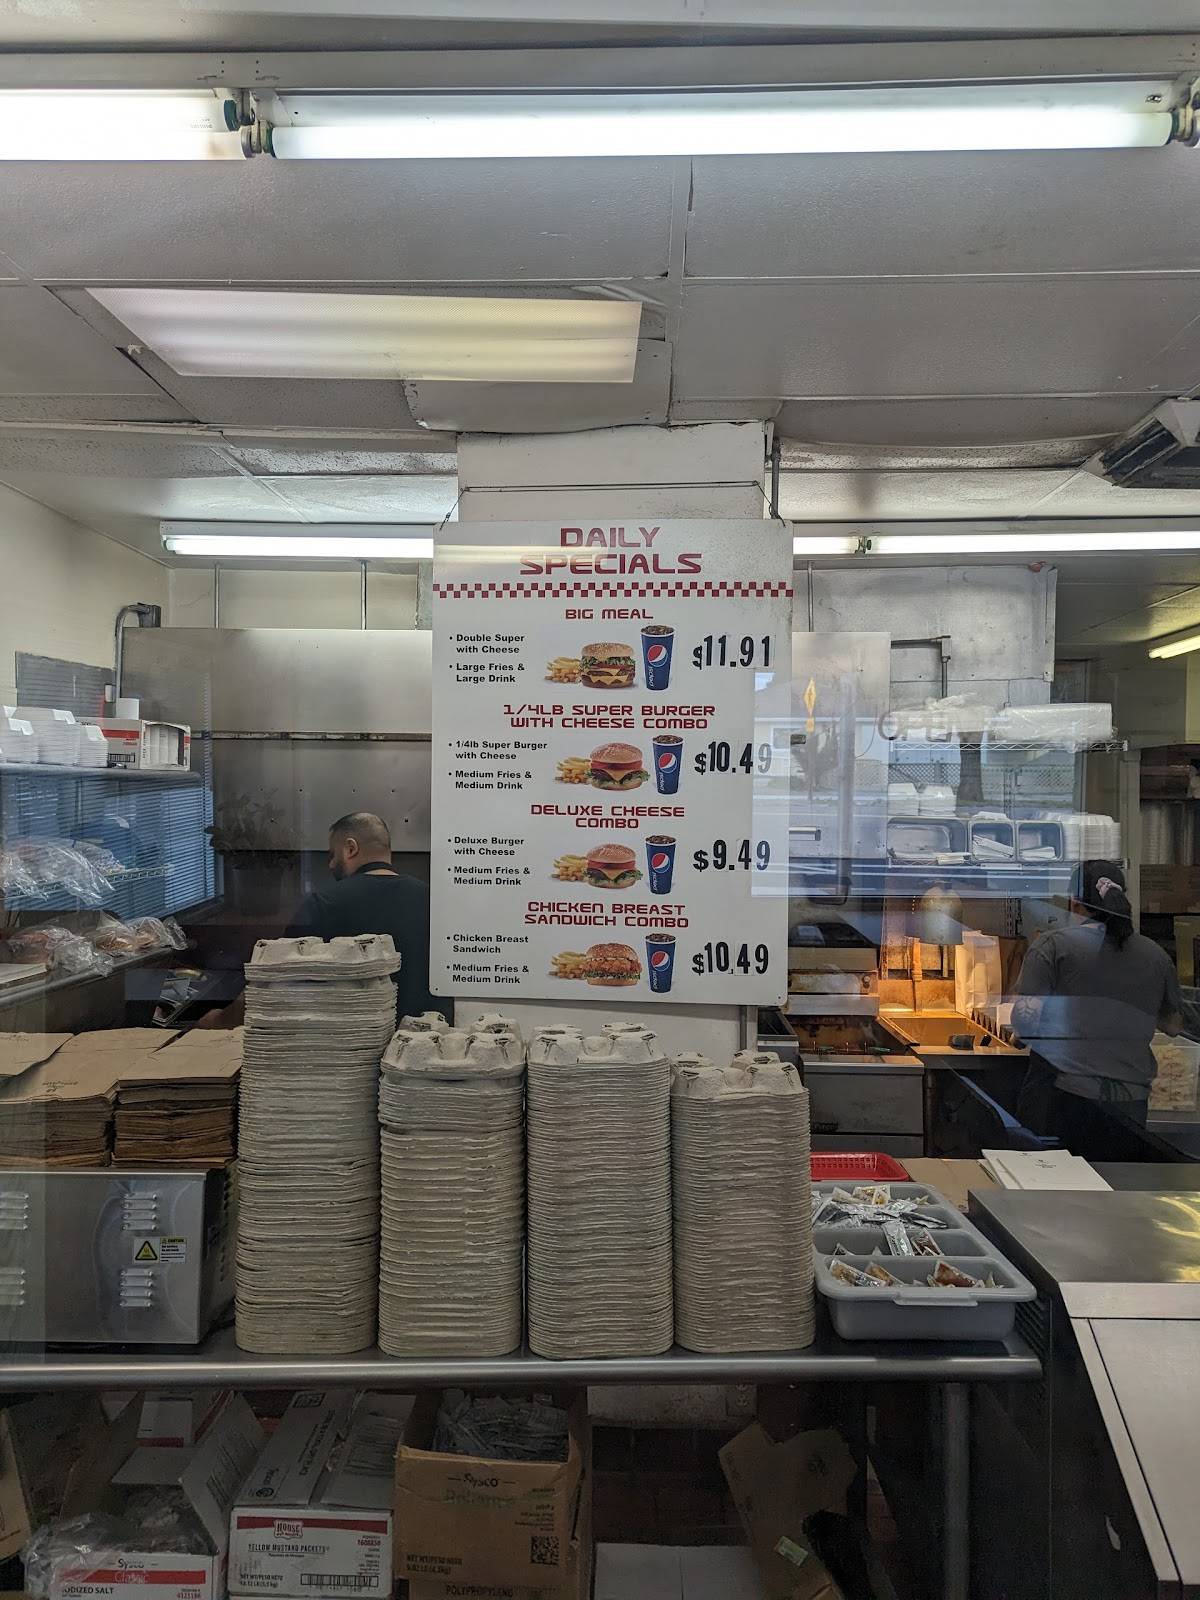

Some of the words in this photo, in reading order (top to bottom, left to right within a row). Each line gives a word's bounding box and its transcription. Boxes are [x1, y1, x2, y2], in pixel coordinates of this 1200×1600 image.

[560, 527, 661, 548] DAILY
[519, 553, 702, 575] SPECIALS
[565, 608, 594, 620] BIG
[601, 608, 654, 620] MEAL
[456, 633, 492, 642] Double
[494, 633, 525, 644] Super
[456, 645, 479, 654] with
[481, 645, 520, 654] Cheese
[691, 634, 771, 671] $11.91
[456, 662, 486, 673] Large
[488, 662, 514, 671] Fries
[517, 663, 526, 671] &
[456, 674, 486, 684] Large
[488, 674, 516, 683] Drink
[503, 704, 564, 715] 1/4LB
[571, 705, 633, 716] SUPER
[641, 705, 716, 717] BURGER
[510, 717, 554, 728] WITH
[561, 717, 635, 729] CHEESE
[643, 718, 708, 730] COMBO
[455, 740, 479, 749] 1/4lb
[482, 740, 511, 750] Super
[514, 741, 548, 751] Burger
[455, 751, 477, 759] with
[479, 751, 517, 760] Cheese
[694, 741, 772, 776] $10.49
[455, 770, 494, 778] Medium
[497, 770, 521, 779] Fries
[524, 771, 532, 779] &
[455, 781, 494, 789] Medium
[497, 781, 523, 790] Drink
[530, 804, 603, 816] DELUXE
[610, 806, 685, 817] CHEESE
[575, 817, 640, 829] COMBO
[454, 836, 488, 845] Deluxe
[491, 836, 525, 846] Burger
[453, 847, 476, 855] with
[478, 847, 516, 856] Cheese
[692, 839, 771, 873] $9.49
[453, 866, 493, 874] Medium
[495, 866, 520, 875] Fries
[523, 866, 531, 875] &
[453, 877, 492, 885] Medium
[495, 877, 522, 886] Drink
[527, 901, 604, 913] CHICKEN
[611, 903, 686, 916] BREAST
[524, 914, 617, 927] SANDWICH
[624, 916, 689, 928] COMBO
[453, 934, 493, 943] Chicken
[495, 934, 529, 943] Breast
[452, 944, 502, 954] Sandwich
[691, 941, 769, 976] $10.49
[452, 963, 491, 972] Medium
[494, 964, 519, 973] Fries
[522, 965, 530, 973] &
[452, 974, 491, 983] Medium
[494, 975, 521, 984] Drink
[63, 1586, 94, 1594] ODIZED
[95, 1586, 114, 1595] SALT
